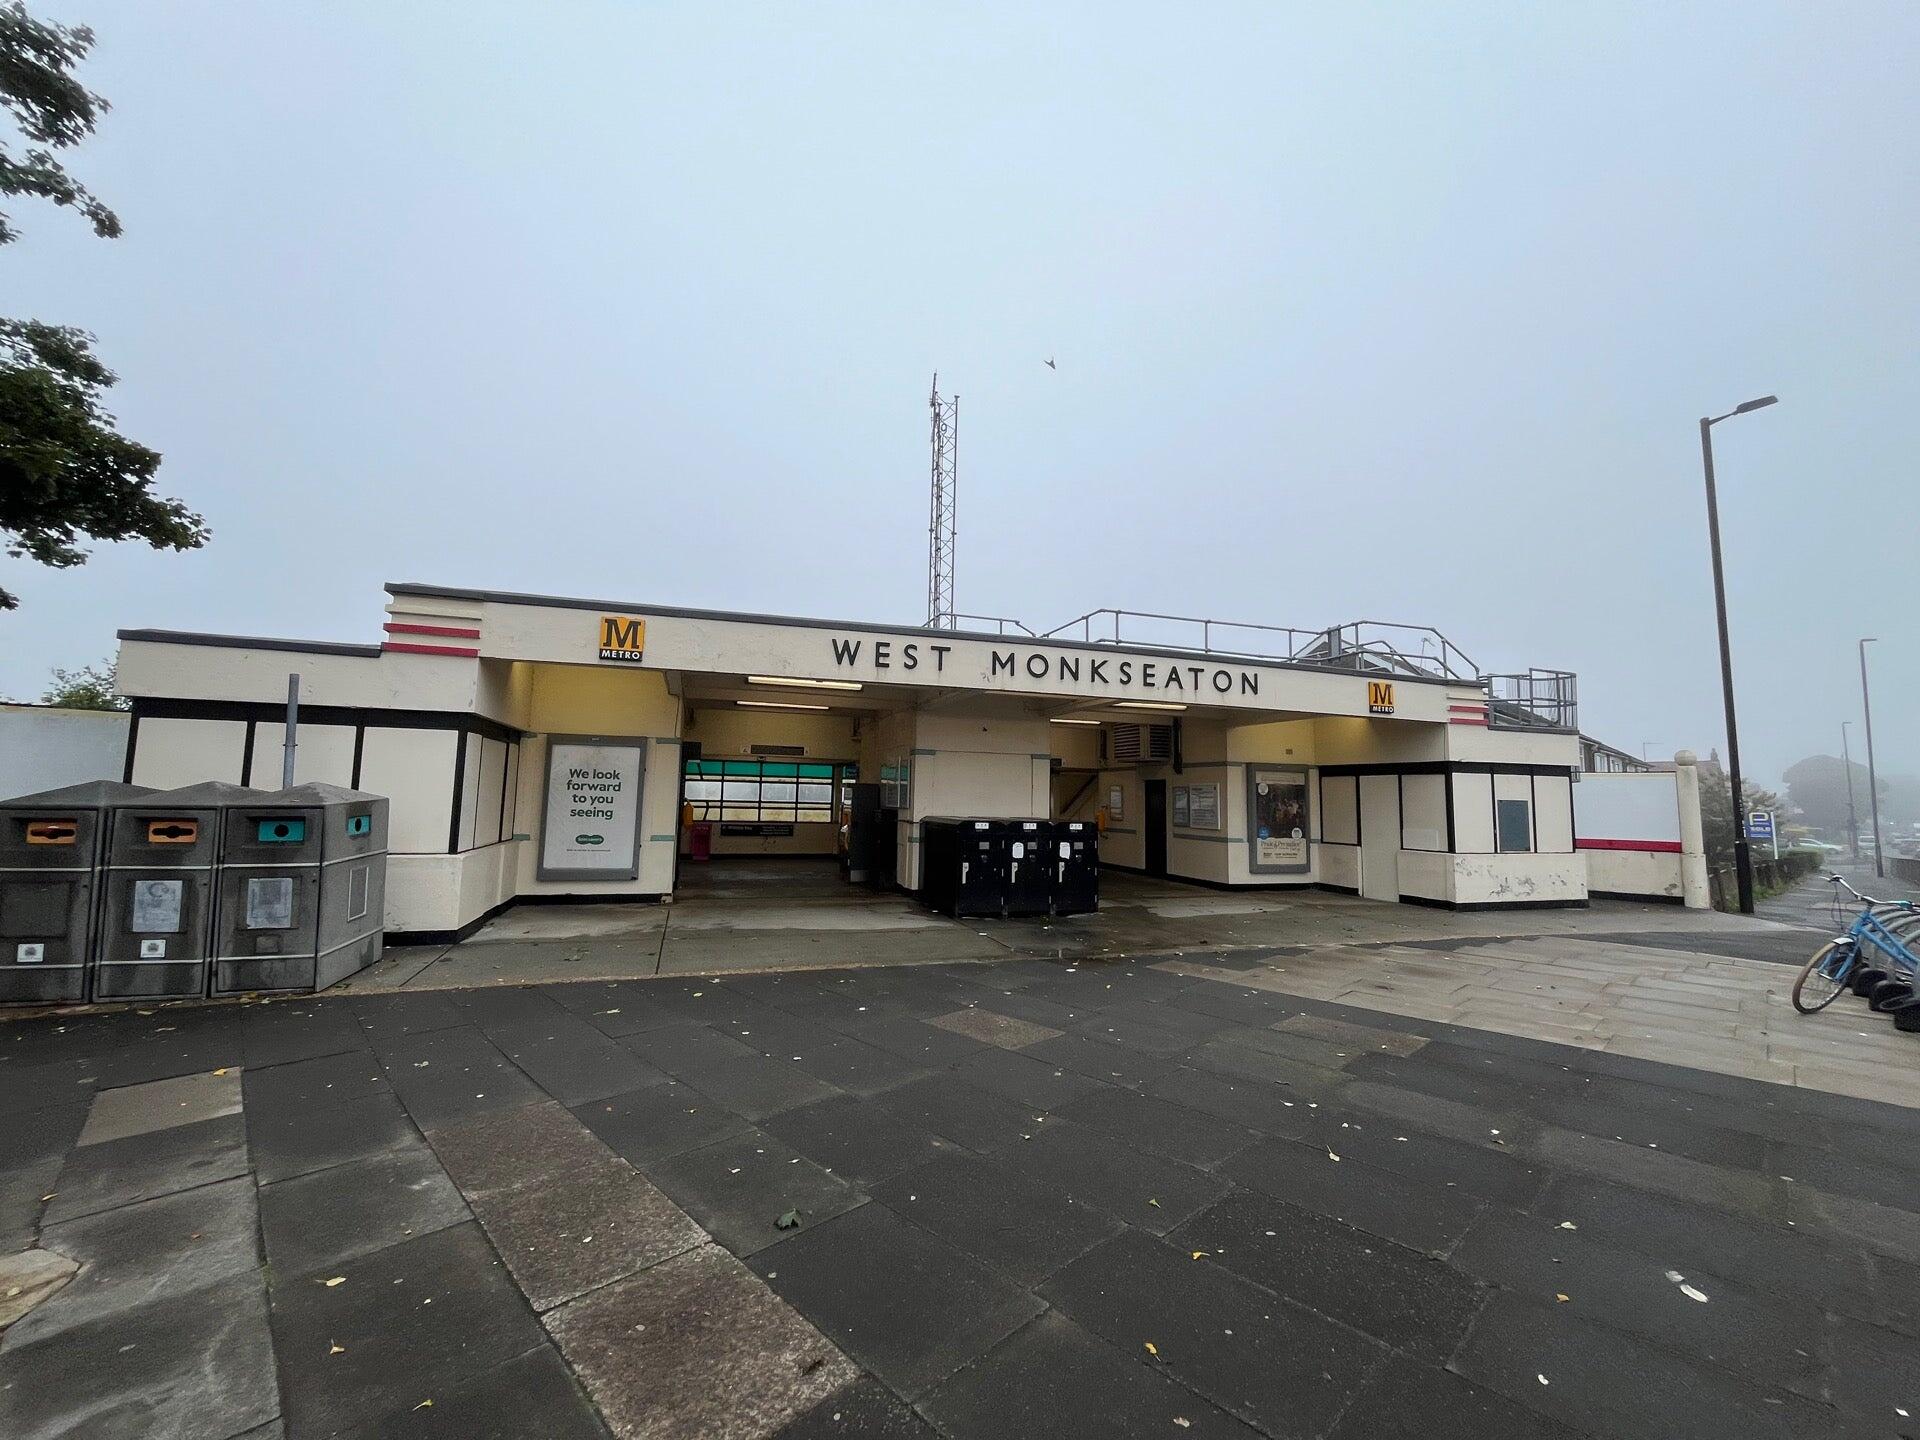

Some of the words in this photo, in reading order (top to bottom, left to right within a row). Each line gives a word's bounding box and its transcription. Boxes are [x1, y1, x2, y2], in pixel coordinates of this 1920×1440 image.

[603, 619, 641, 649] M
[601, 650, 640, 660] METRO
[832, 638, 951, 671] WEST
[991, 650, 1259, 695] MONKSEATON
[1373, 683, 1392, 705] M
[569, 769, 589, 779] We
[593, 769, 620, 780] look
[567, 780, 621, 792] forward
[572, 794, 587, 803] to
[590, 796, 614, 806] you
[570, 807, 613, 820] seeing
